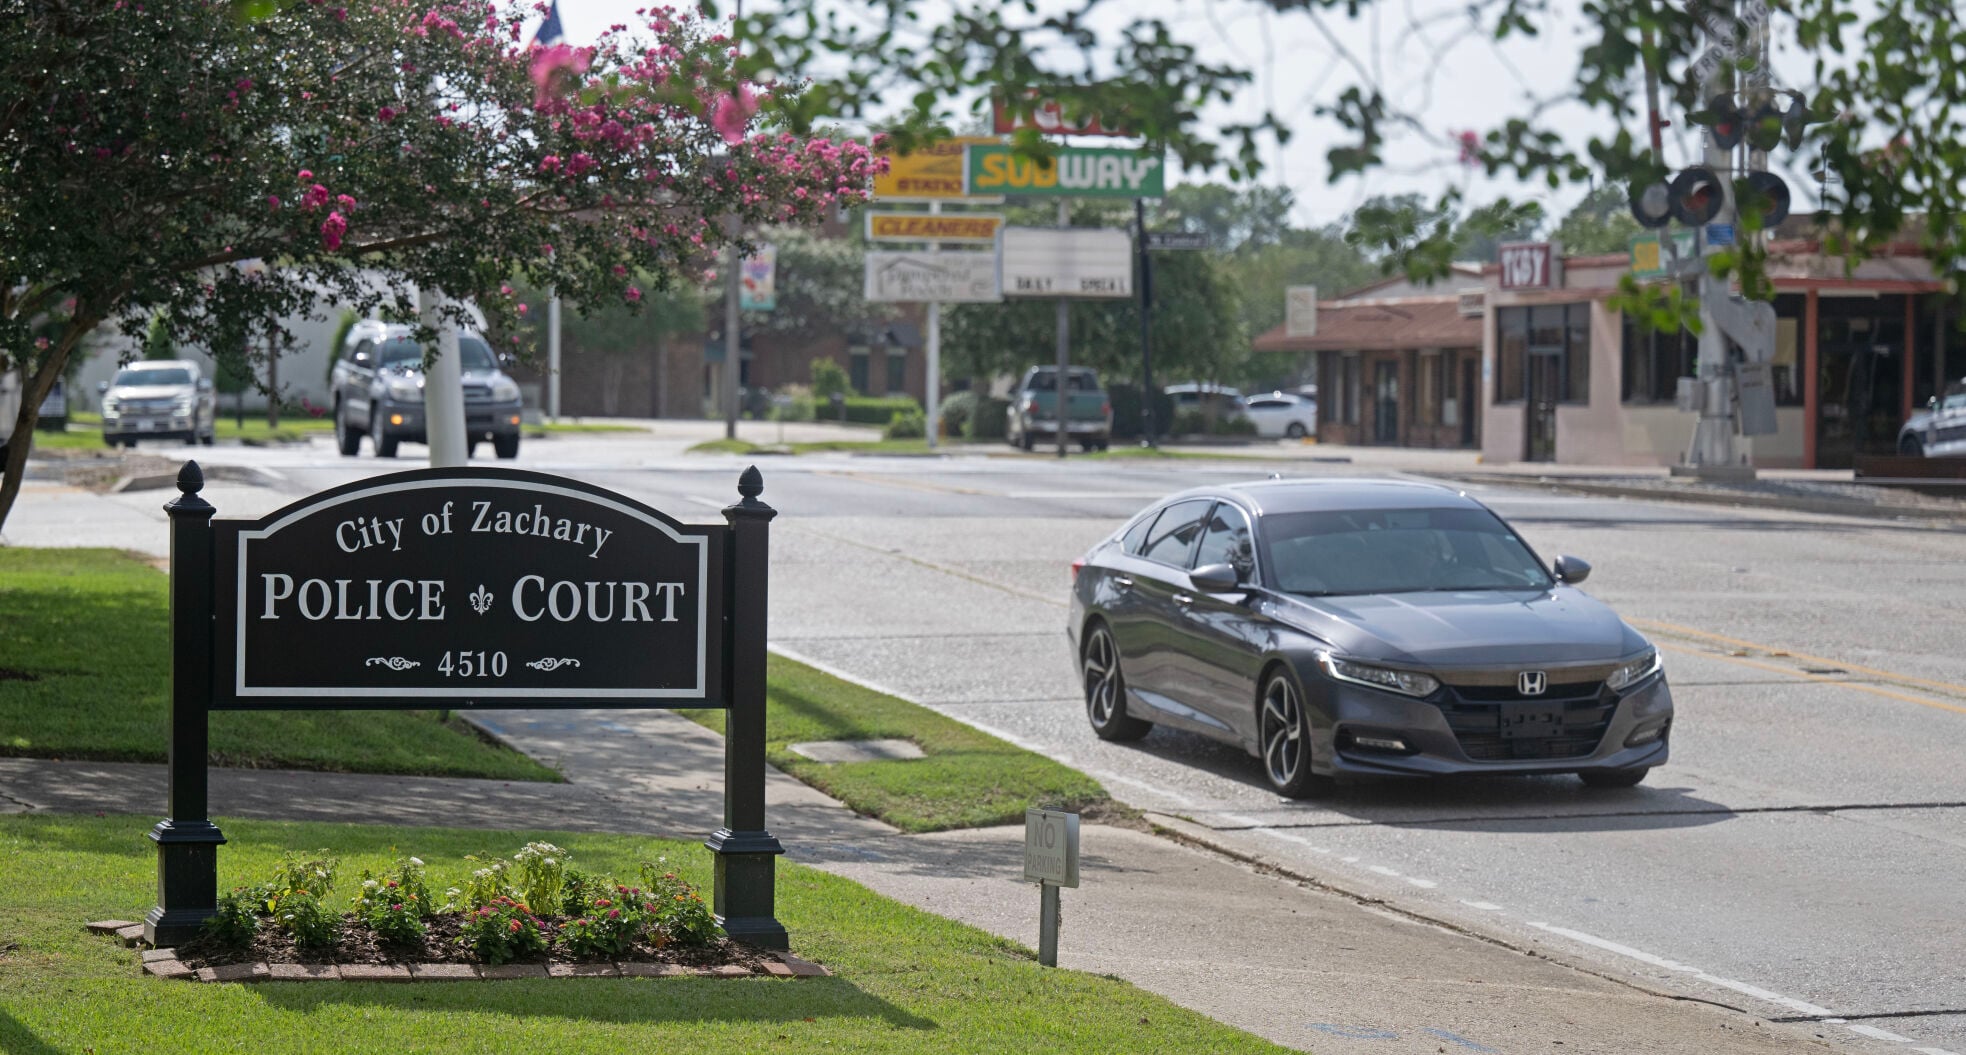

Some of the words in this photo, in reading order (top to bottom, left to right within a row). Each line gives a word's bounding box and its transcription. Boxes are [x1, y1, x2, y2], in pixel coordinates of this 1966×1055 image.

[1692, 2, 1769, 80] CROSNG
[898, 177, 963, 193] STATIO
[976, 153, 1159, 189] SUBWAY
[878, 218, 993, 237] CLEANERS
[336, 517, 403, 552] City
[422, 501, 453, 535] of
[471, 499, 613, 558] Zachary
[261, 574, 445, 620] POLICE
[513, 575, 684, 621] COURT
[438, 651, 507, 676] 4510
[1033, 821, 1056, 850] NO
[1027, 853, 1062, 875] PARKING
